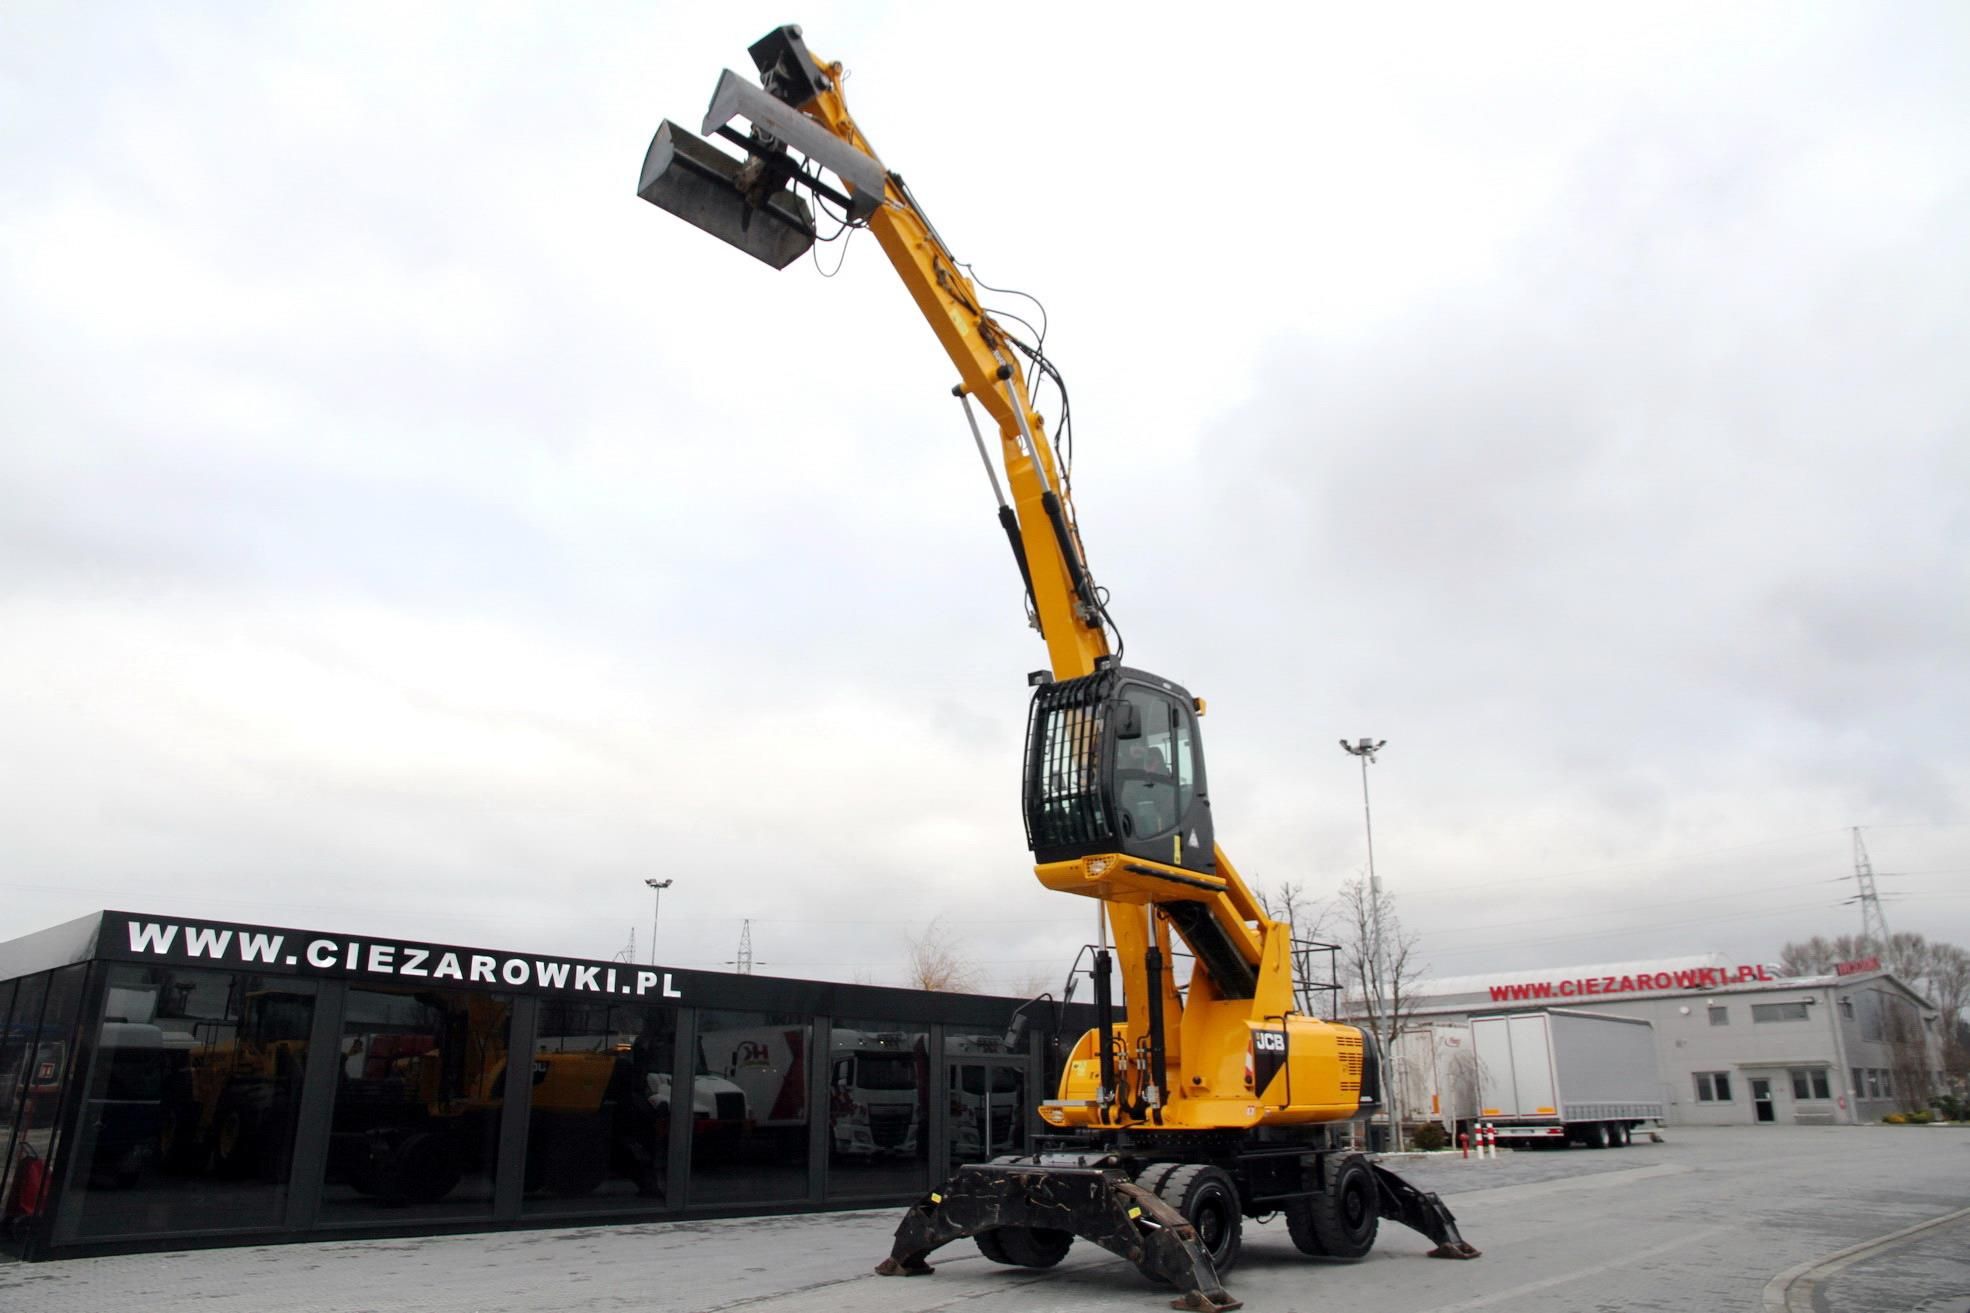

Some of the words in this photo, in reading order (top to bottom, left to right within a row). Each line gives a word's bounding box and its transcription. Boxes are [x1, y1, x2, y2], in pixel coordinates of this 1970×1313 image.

[128, 921, 682, 998] WWW.CIEZAROWKI.PL
[1488, 964, 1774, 1002] WWW.CIEZAROWKI.PL
[1255, 1032, 1285, 1051] JCB
